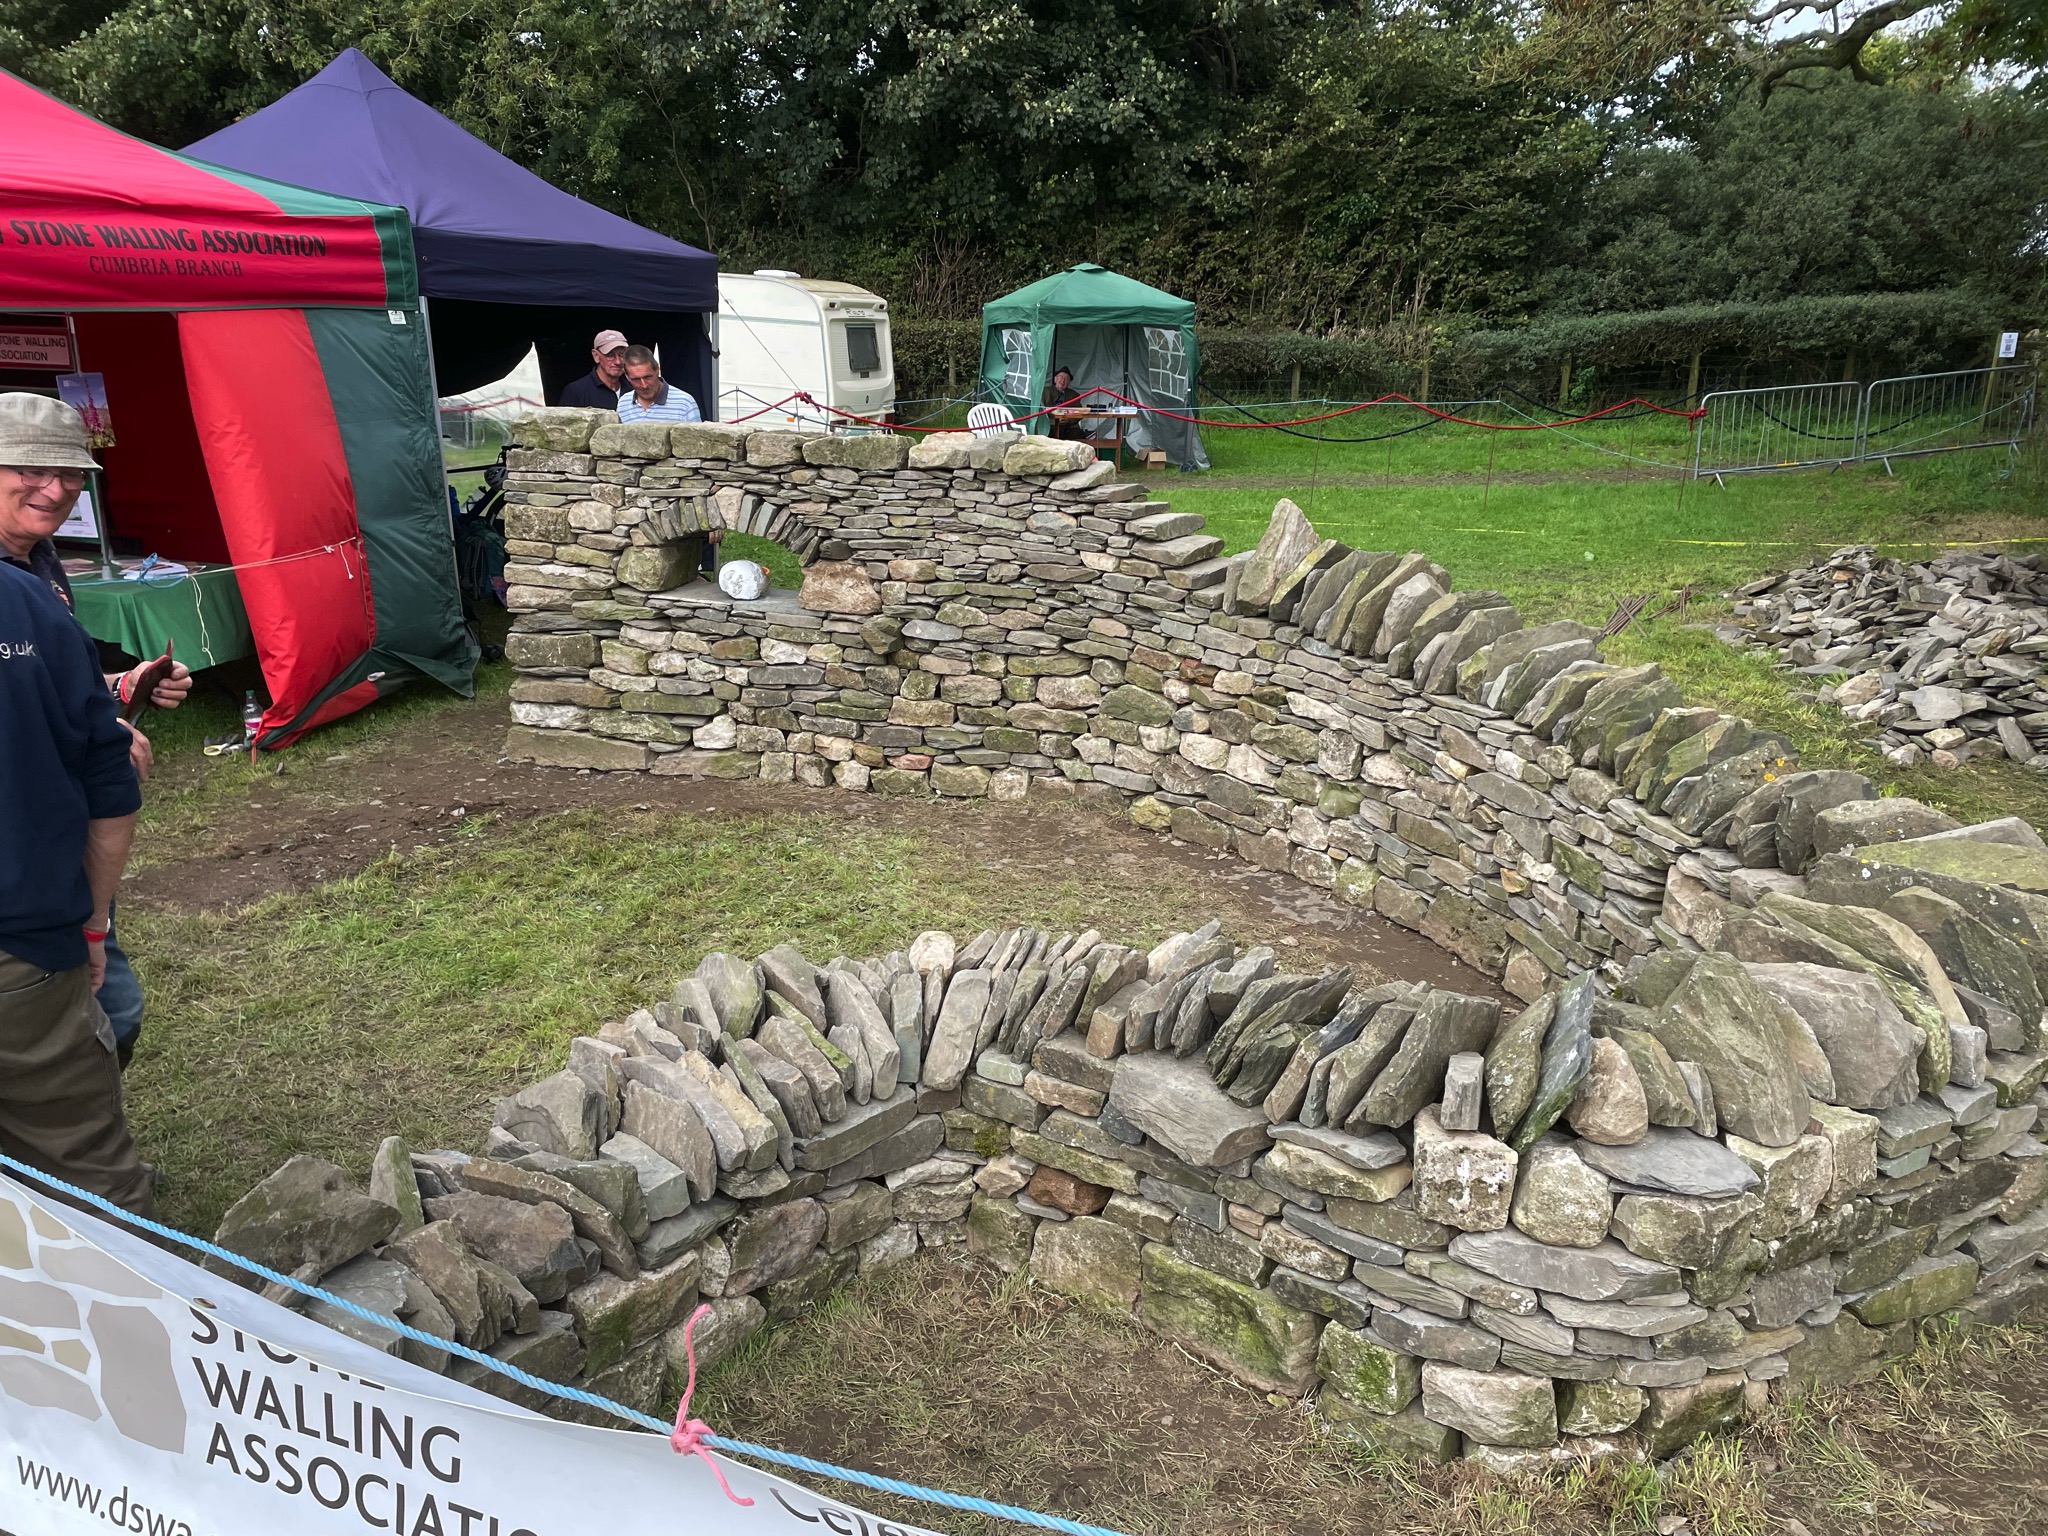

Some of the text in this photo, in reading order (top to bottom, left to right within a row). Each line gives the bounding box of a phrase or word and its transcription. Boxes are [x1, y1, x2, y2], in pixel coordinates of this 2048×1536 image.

[10, 219, 95, 247] STONE
[93, 224, 197, 252] WALLING
[201, 229, 326, 257] ASSOCIATION
[89, 255, 243, 277] CUMBRIA BRANCH
[23, 336, 66, 348] WALLING
[191, 1356, 461, 1483] WALLING
